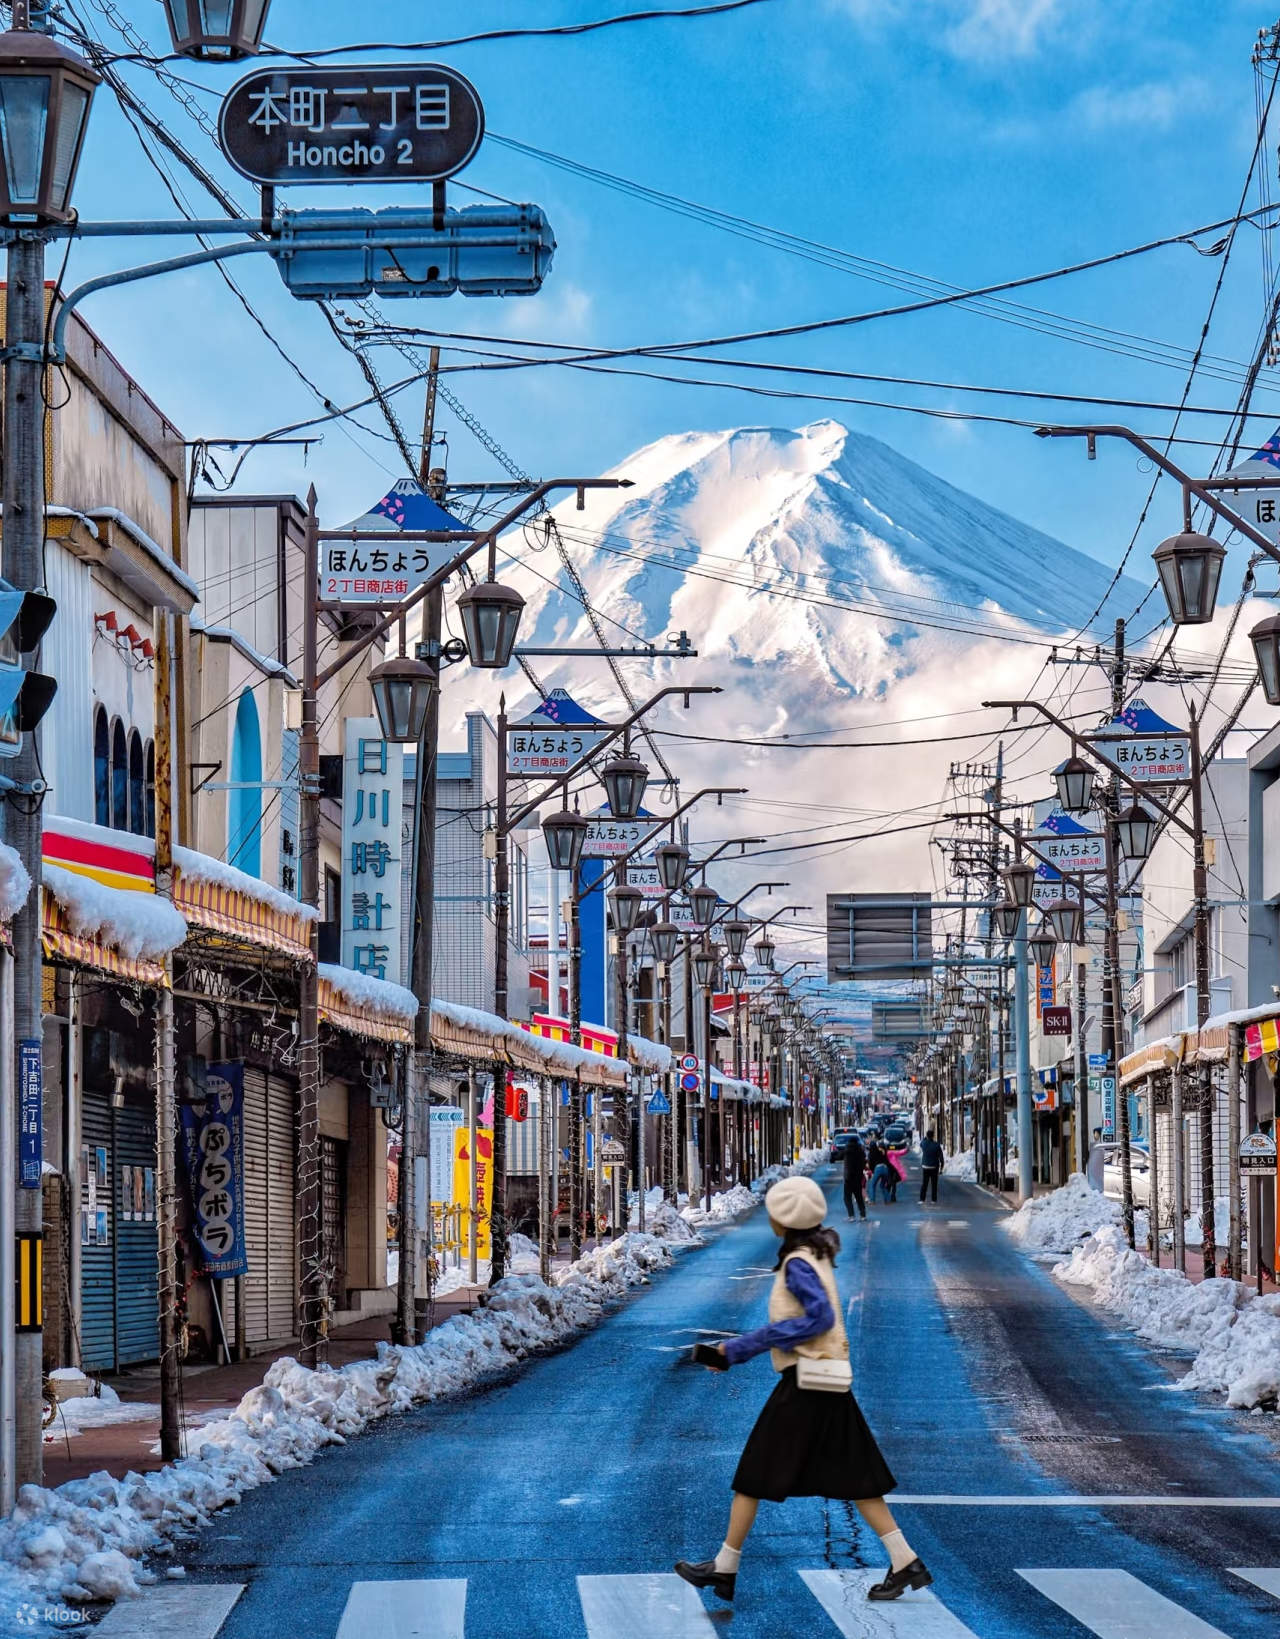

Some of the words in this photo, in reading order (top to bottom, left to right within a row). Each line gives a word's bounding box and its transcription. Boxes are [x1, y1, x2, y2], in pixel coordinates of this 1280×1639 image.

[248, 84, 450, 135] 本町二丁目
[287, 140, 385, 167] Honcho
[397, 139, 413, 165] 2
[1257, 499, 1280, 523] ほ
[328, 548, 430, 573] ほんちょう
[513, 736, 583, 754] ほんちょう
[1116, 744, 1184, 762] ほんちょう
[586, 827, 639, 840] ほんちょう
[352, 737, 391, 980] 日川時計店
[1048, 842, 1101, 857] ほんちょう
[629, 873, 662, 884] ほんち
[28, 1057, 39, 1134] 下吉田二丁目
[205, 1127, 228, 1249] ぷちボラ
